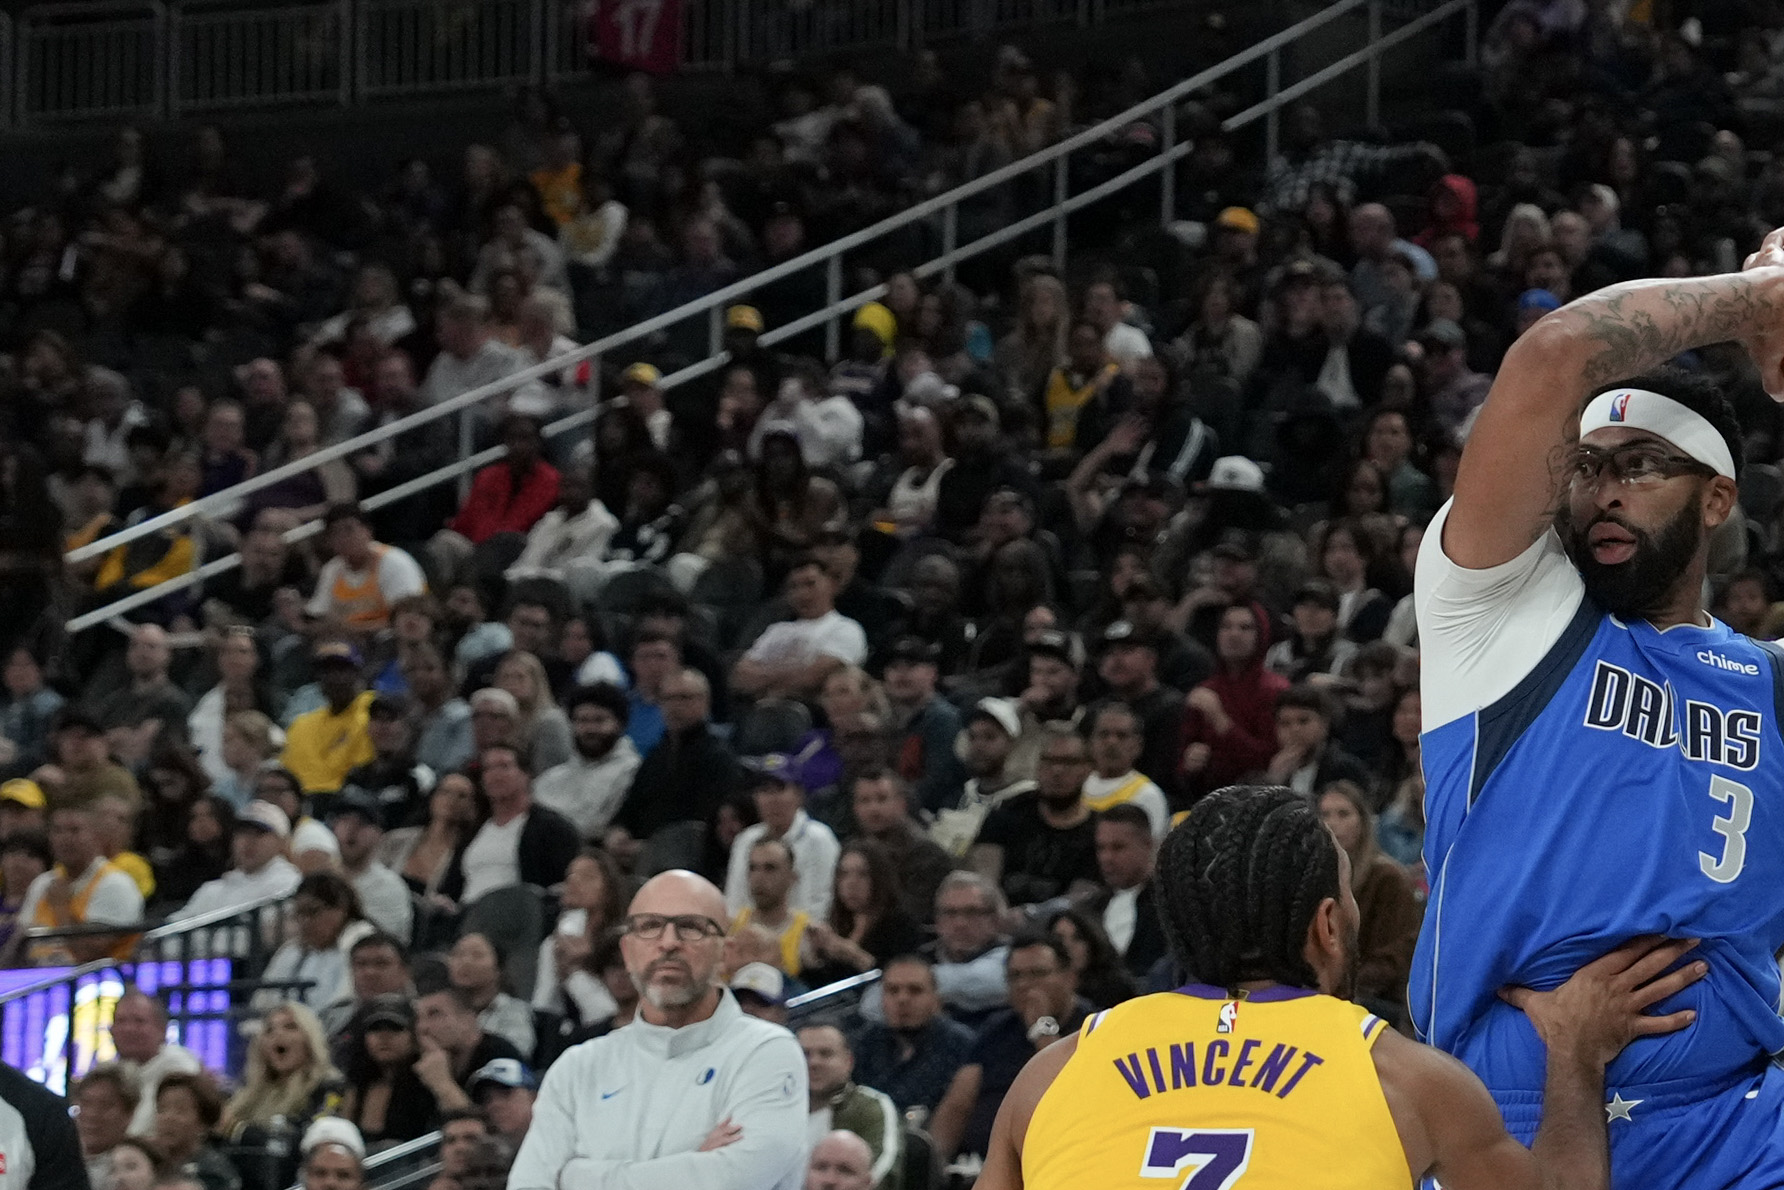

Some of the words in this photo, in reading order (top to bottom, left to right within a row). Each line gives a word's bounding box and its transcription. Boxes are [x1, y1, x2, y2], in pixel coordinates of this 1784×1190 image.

[1697, 650, 1760, 676] chime
[1583, 659, 1762, 772] DALAS
[1698, 773, 1754, 884] 3
[1112, 1038, 1325, 1100] VINCENT
